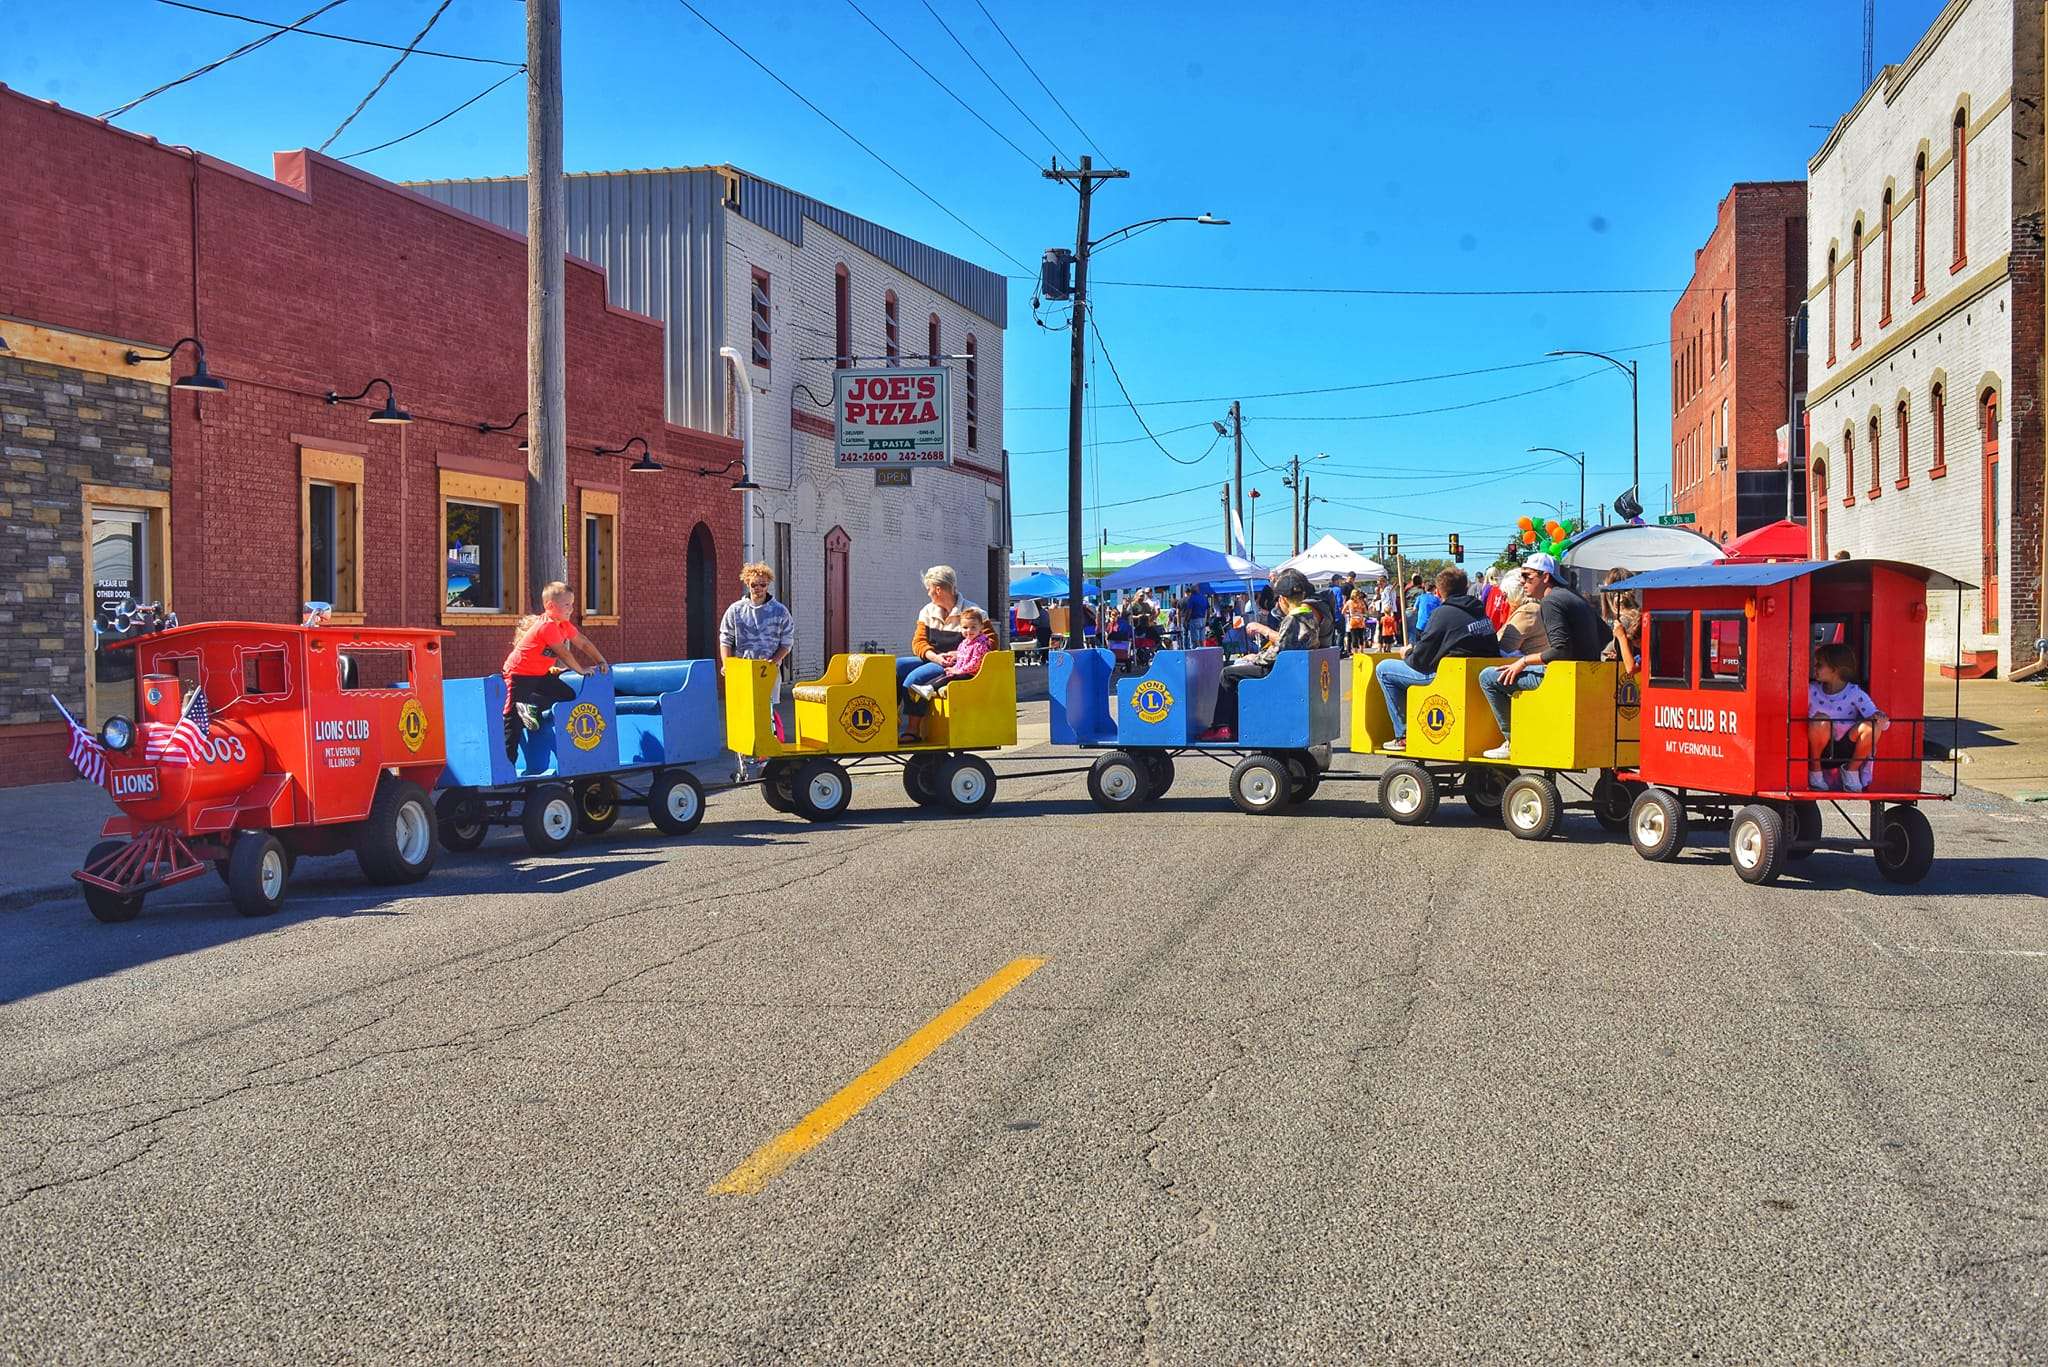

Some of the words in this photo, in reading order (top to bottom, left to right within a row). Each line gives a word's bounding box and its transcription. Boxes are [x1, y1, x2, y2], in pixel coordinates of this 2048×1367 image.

[848, 376, 936, 401] JOE'S
[845, 401, 939, 426] PIZZA
[882, 440, 911, 449] PASTA
[841, 452, 888, 462] 242-2600
[899, 450, 944, 461] 242-2688
[878, 471, 908, 482] OPEN
[114, 590, 130, 598] DOOR
[760, 665, 767, 678] 2
[1138, 681, 1166, 692] LIONS
[1654, 705, 1684, 730] LIONS
[1687, 707, 1715, 732] CLUB
[315, 721, 343, 741] LIONS
[346, 720, 370, 740] CLUB
[328, 758, 355, 768] ILLINOIS
[114, 774, 154, 794] LIONS
